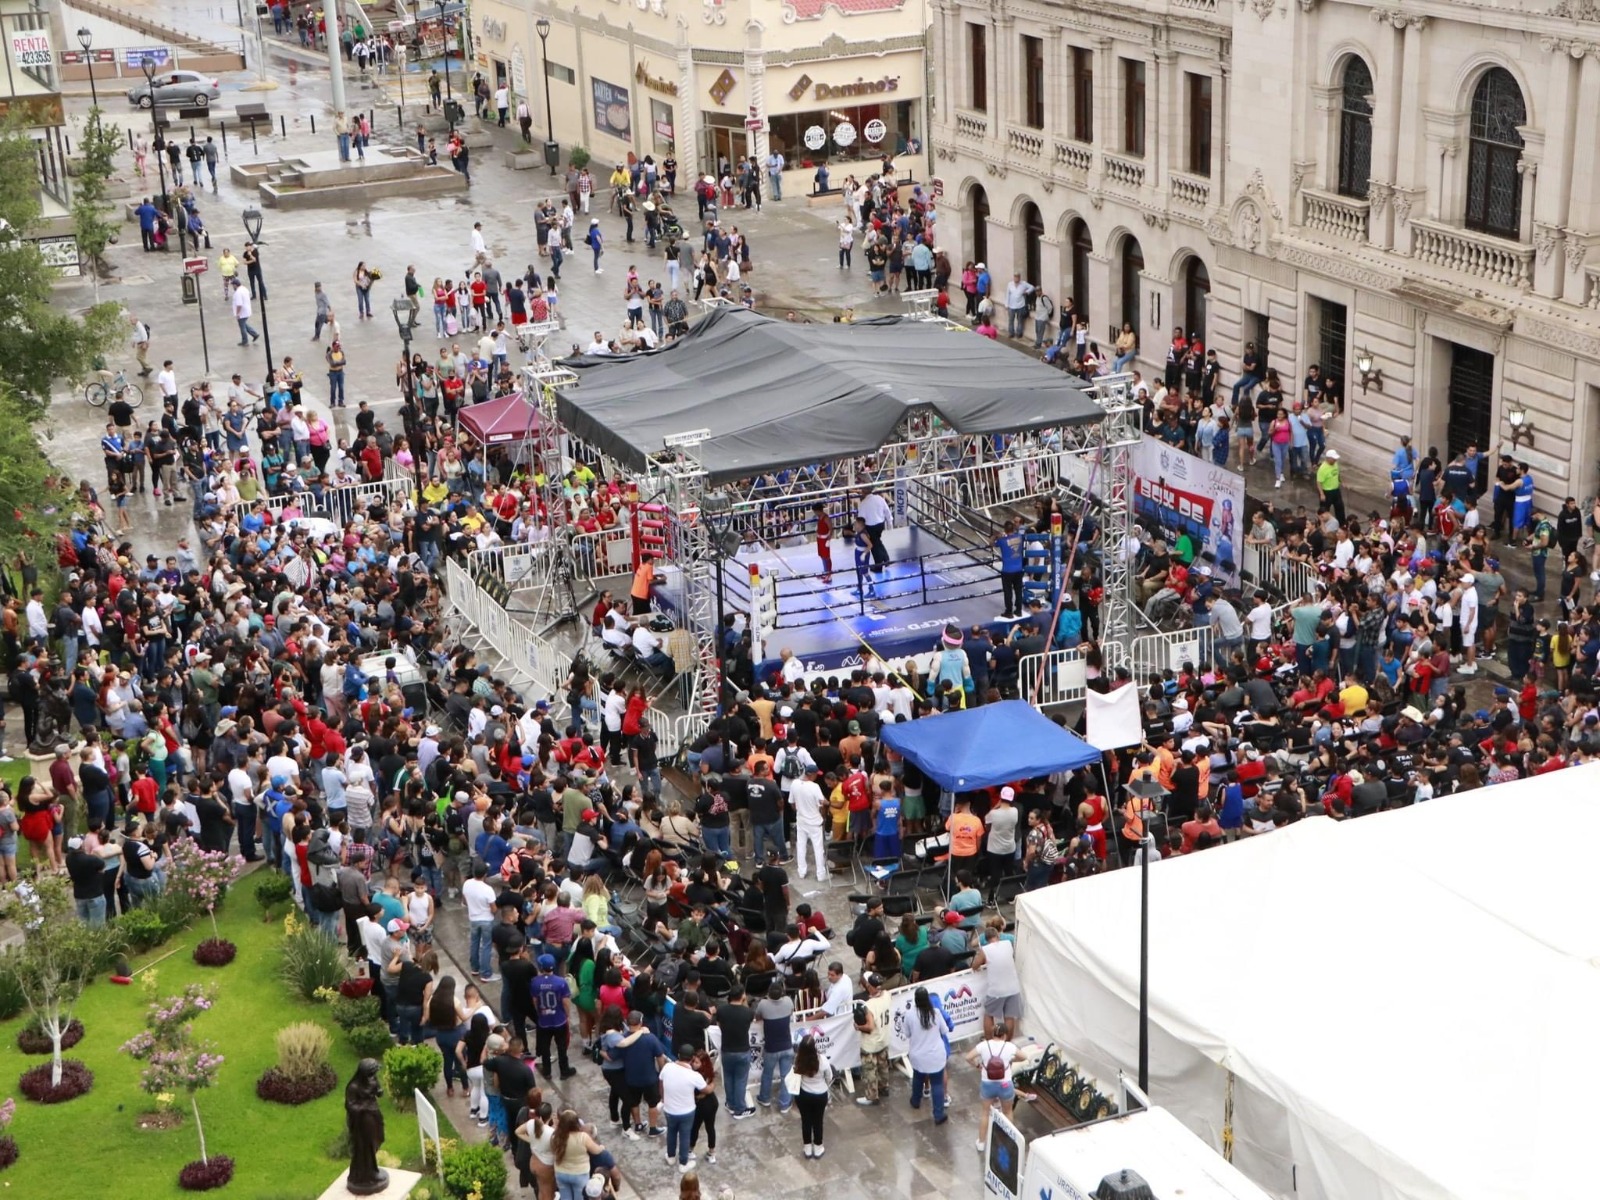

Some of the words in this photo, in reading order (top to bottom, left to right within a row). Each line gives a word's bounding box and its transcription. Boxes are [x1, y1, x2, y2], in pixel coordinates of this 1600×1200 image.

[14, 37, 49, 51] RENTA
[815, 77, 898, 100] Domino's
[1212, 482, 1235, 497] CAPITAL
[896, 489, 905, 515] IMCFD
[1140, 477, 1175, 510] BOX
[1179, 496, 1204, 524] DE
[907, 615, 961, 631] IMCFD
[538, 991, 558, 1009] 10
[943, 997, 978, 1010] hihuahua
